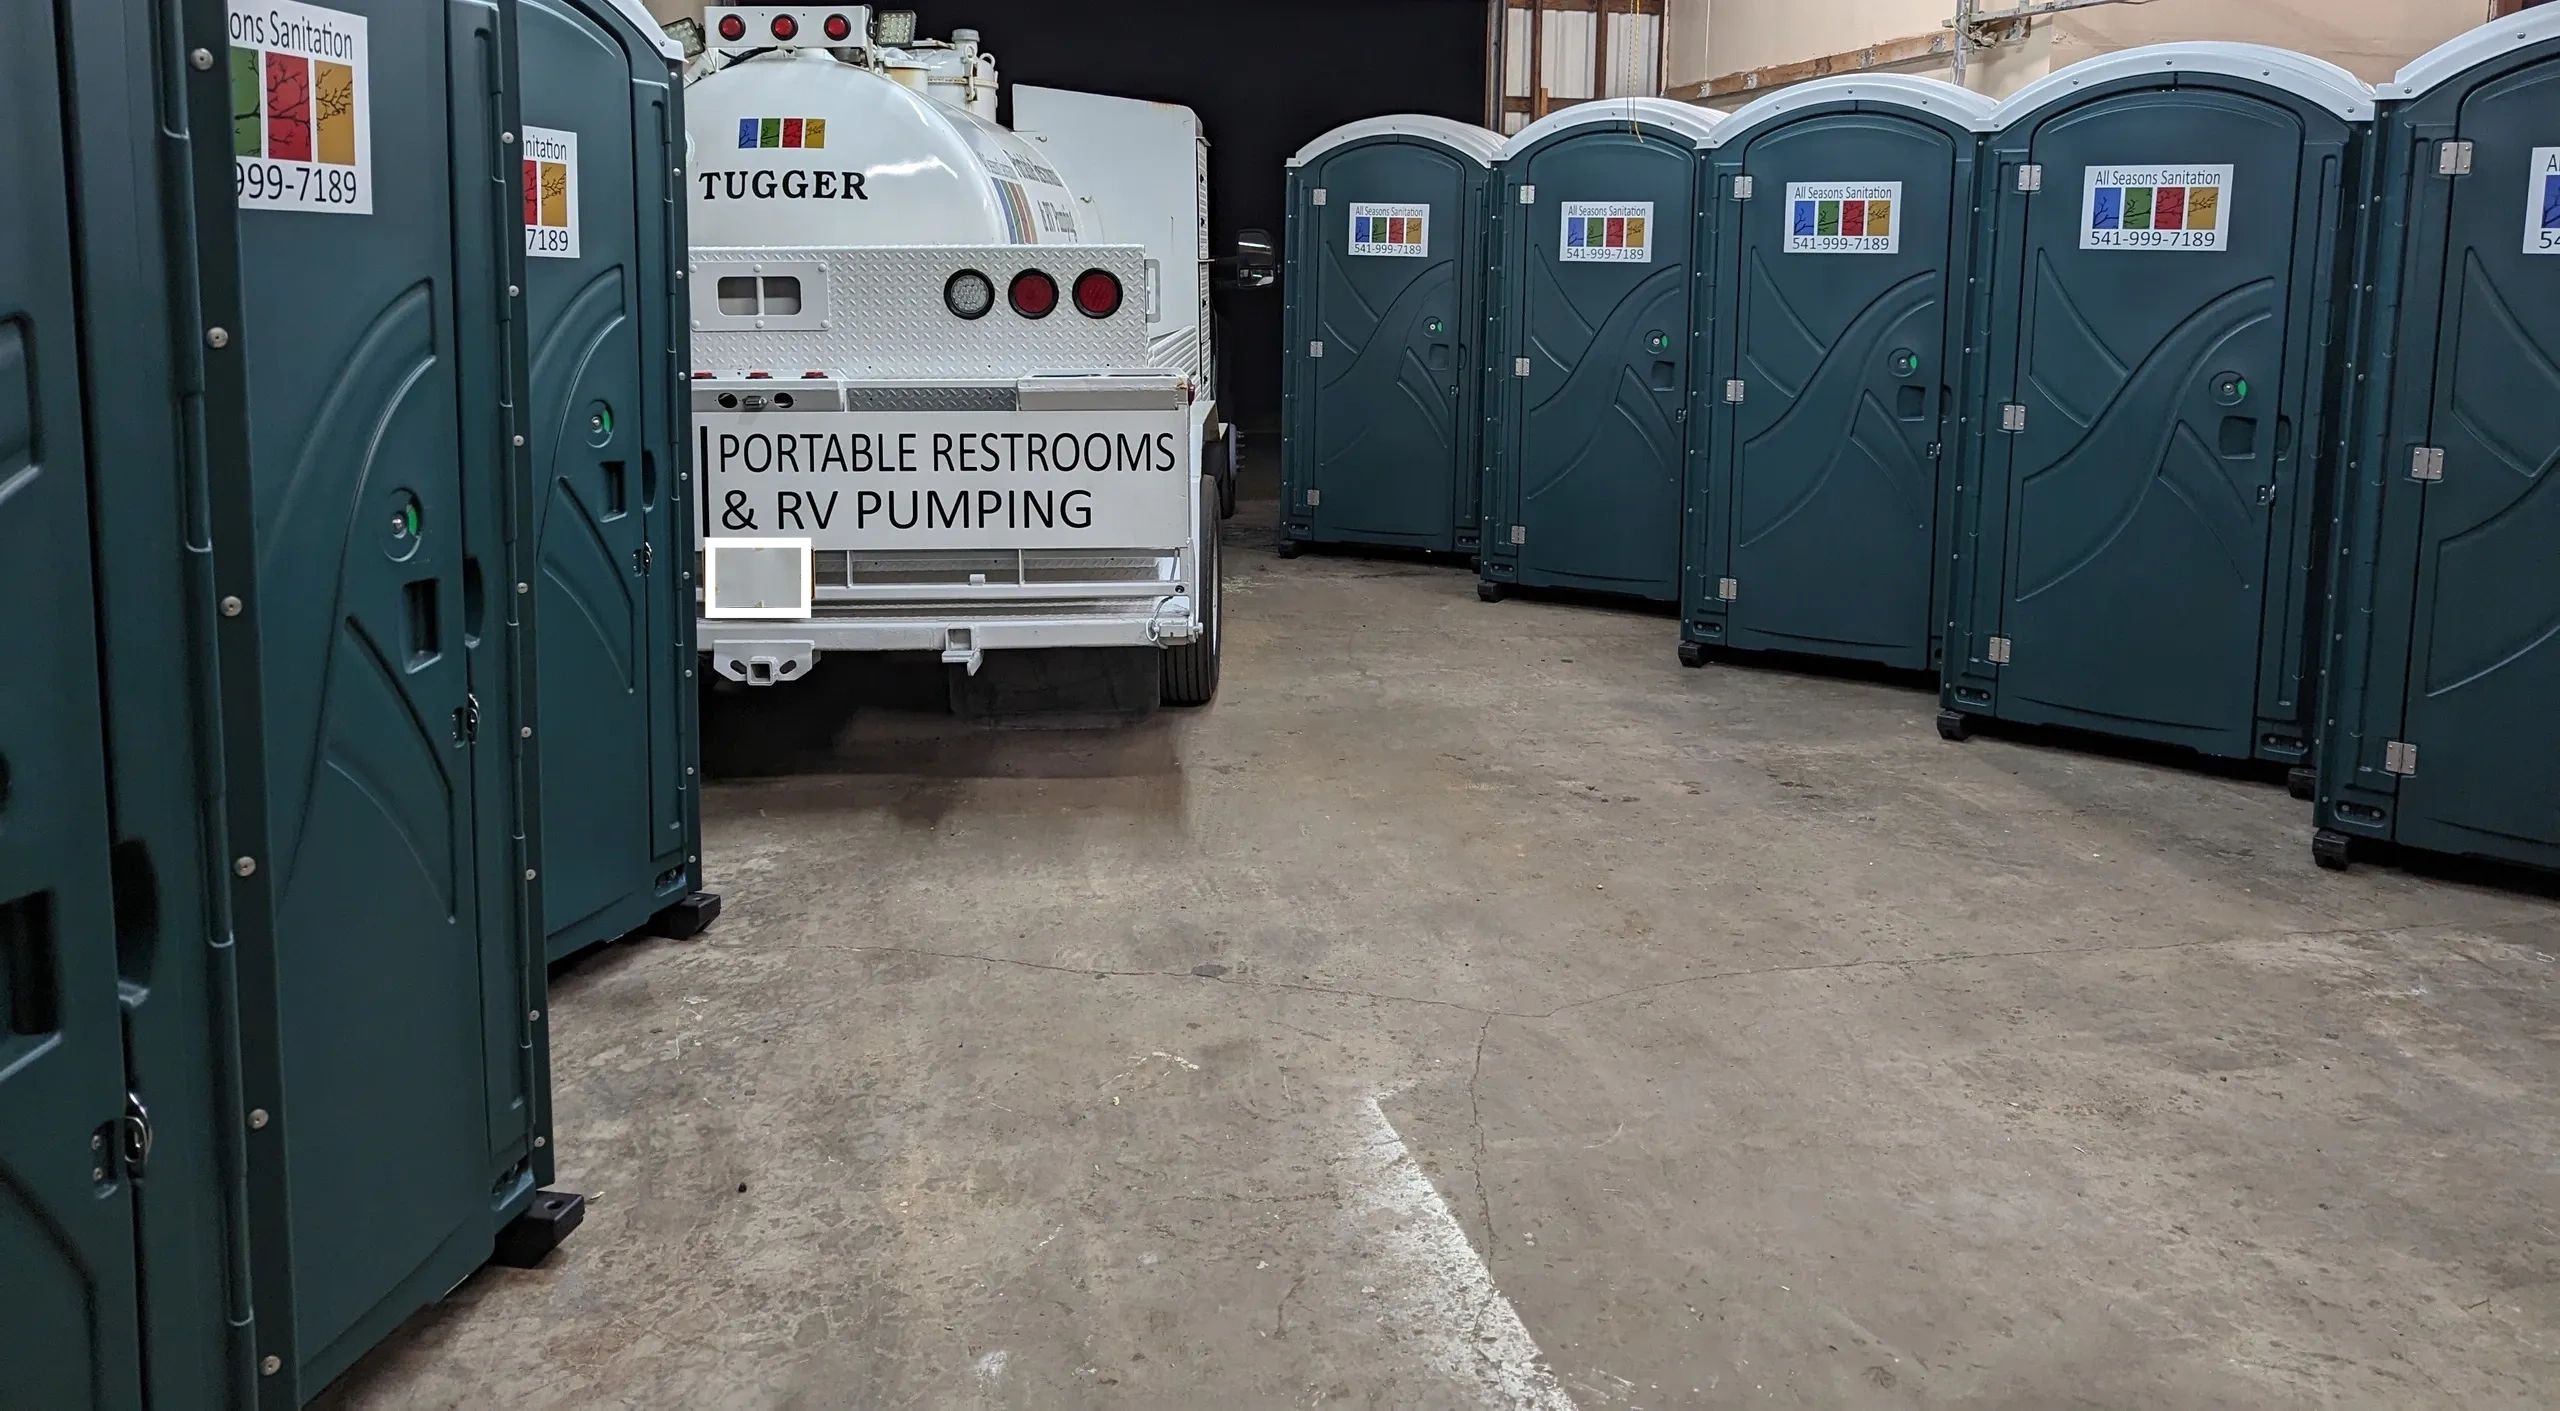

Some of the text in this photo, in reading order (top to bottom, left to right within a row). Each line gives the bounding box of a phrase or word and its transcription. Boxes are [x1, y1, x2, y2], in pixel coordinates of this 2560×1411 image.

[270, 10, 353, 60] Sanitation
[698, 169, 869, 200] TUGGER
[2095, 169, 2221, 185] All Seasons Sanitation
[1794, 186, 1892, 199] All Seasons Sanitation
[1355, 206, 1423, 217] All Seasons Sanitation
[1567, 205, 1646, 217] All Seasons Sanitation
[526, 228, 569, 252] 7189
[1792, 237, 1889, 250] 541-999-7189
[2091, 231, 2215, 247] 541-999-7189
[1354, 244, 1422, 255] 541-999-7189
[1566, 248, 1644, 260] 541-999-7189
[719, 432, 1176, 473] PORTABLE RESTROOMS
[721, 489, 1092, 531] & RV PUMPING
